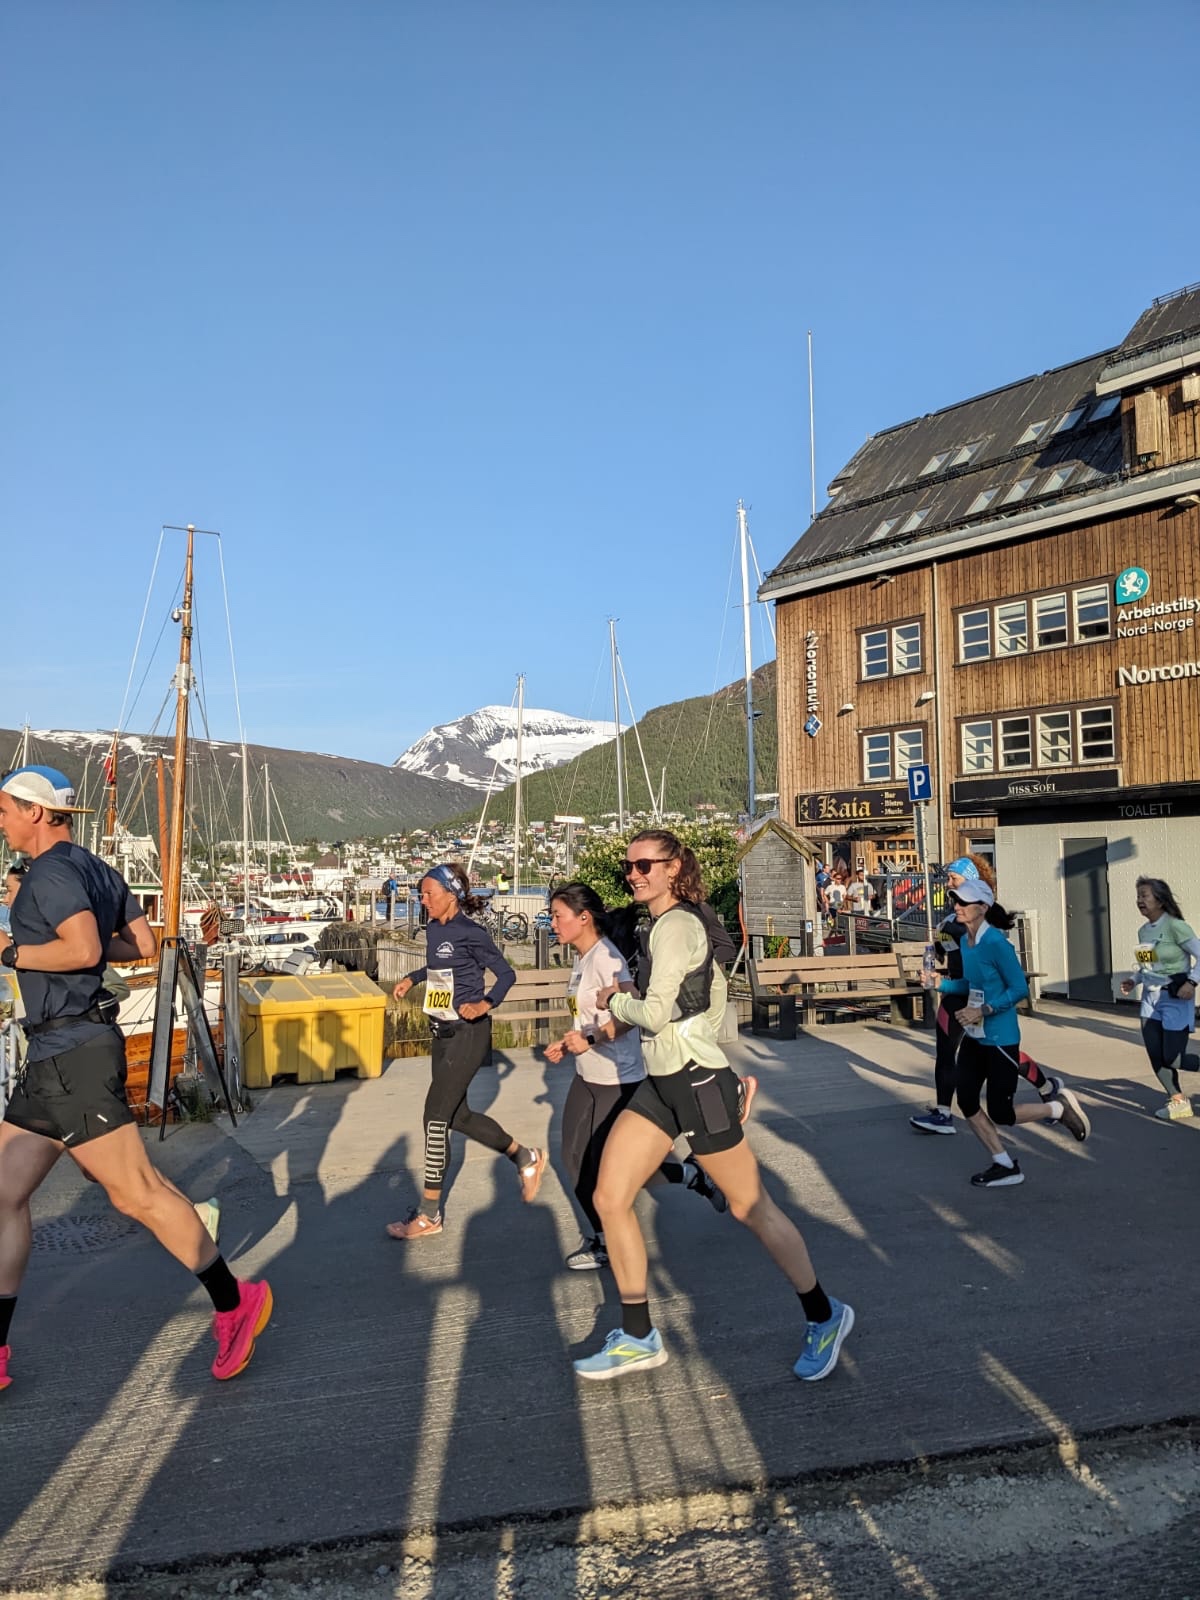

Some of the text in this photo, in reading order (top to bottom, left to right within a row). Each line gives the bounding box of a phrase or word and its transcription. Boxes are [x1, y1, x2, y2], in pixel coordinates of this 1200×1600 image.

[1117, 617, 1194, 638] Nord-Norge
[913, 770, 925, 796] P
[1008, 785, 1030, 796] MISS
[817, 795, 872, 819] Kaia
[1118, 802, 1172, 817] TOALETT
[428, 991, 451, 1009] 1020
[425, 1120, 448, 1182] PUMA
